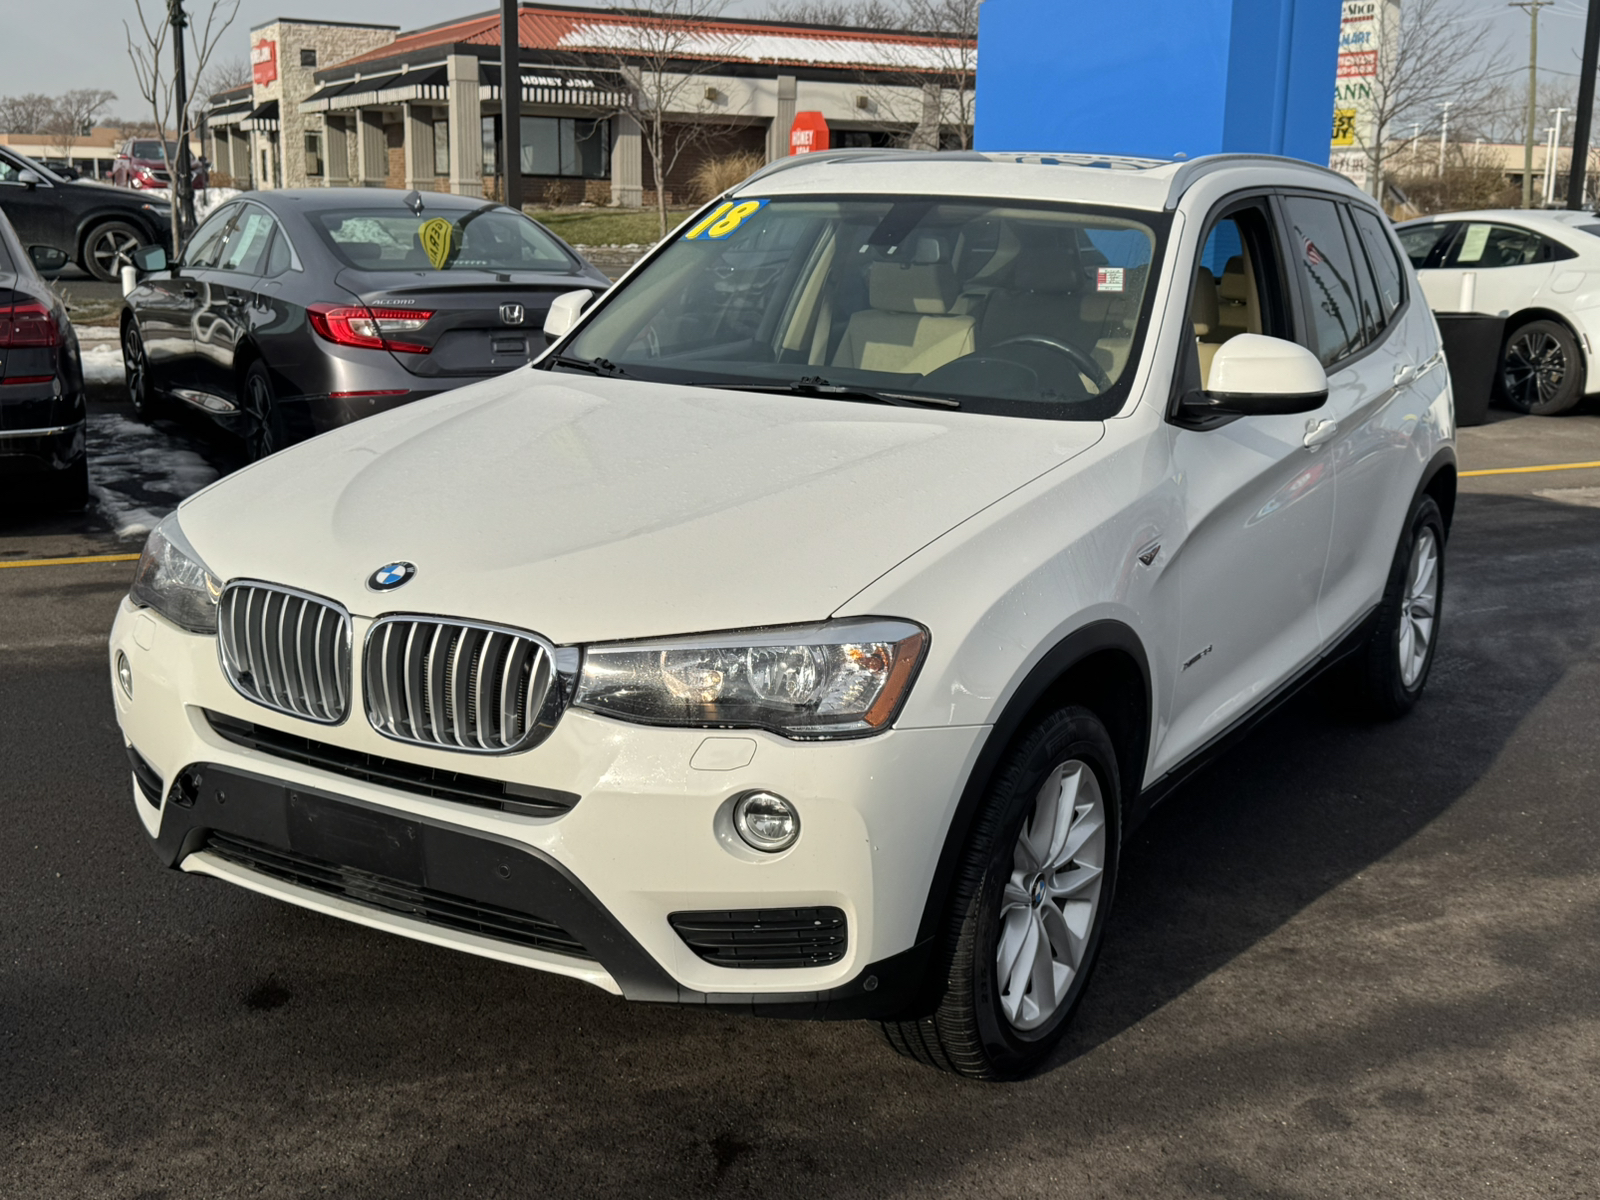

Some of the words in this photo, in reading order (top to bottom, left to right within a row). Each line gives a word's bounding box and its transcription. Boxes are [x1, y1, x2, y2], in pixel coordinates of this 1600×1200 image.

[1340, 31, 1372, 46] MART
[520, 75, 562, 87] HONEY
[565, 79, 595, 88] JAM
[685, 201, 760, 240] 18
[372, 298, 416, 306] ACCORD
